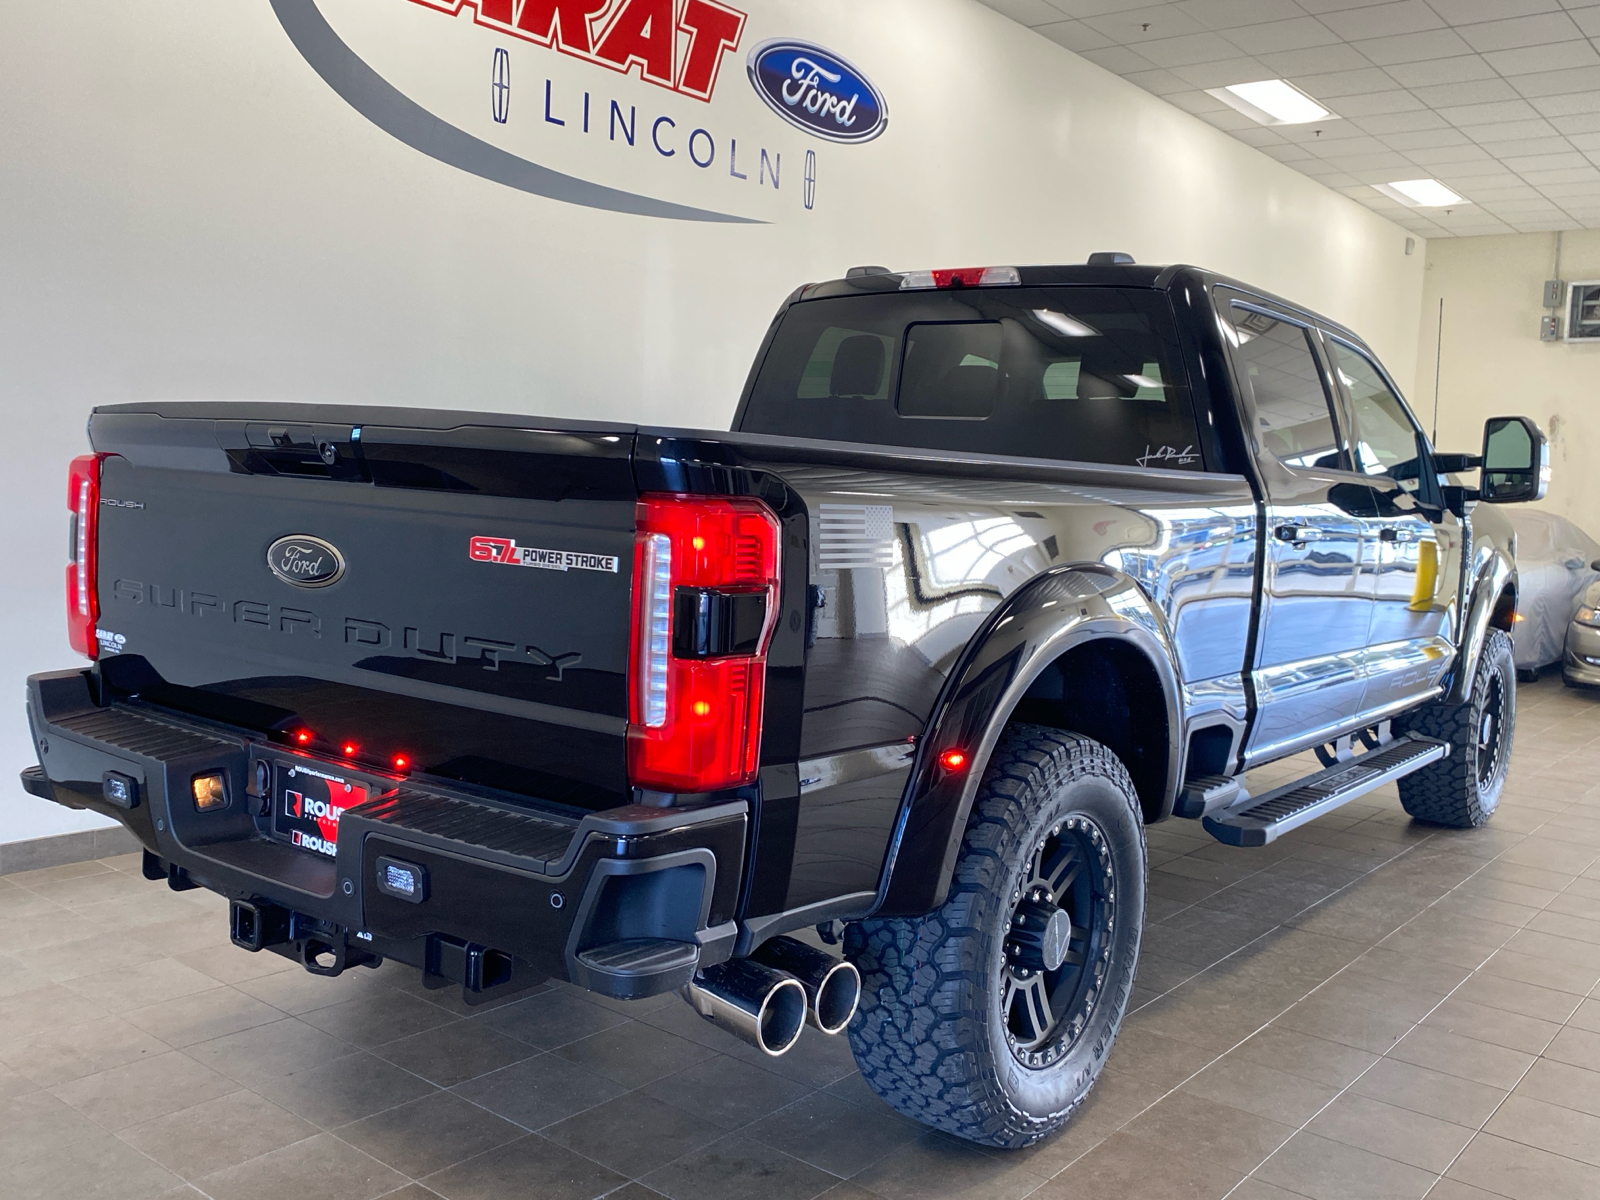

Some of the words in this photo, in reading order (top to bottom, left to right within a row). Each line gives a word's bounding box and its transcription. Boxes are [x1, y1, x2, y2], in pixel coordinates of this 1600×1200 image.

[782, 57, 859, 127] Ford
[543, 78, 781, 191] LINCOLN
[99, 497, 146, 510] ROUSH
[281, 545, 323, 576] Ford
[470, 536, 521, 565] 6.7L
[522, 548, 563, 565] POWER
[565, 552, 613, 570] STROKE
[113, 578, 322, 639] SUPER
[345, 617, 582, 682] DUTY
